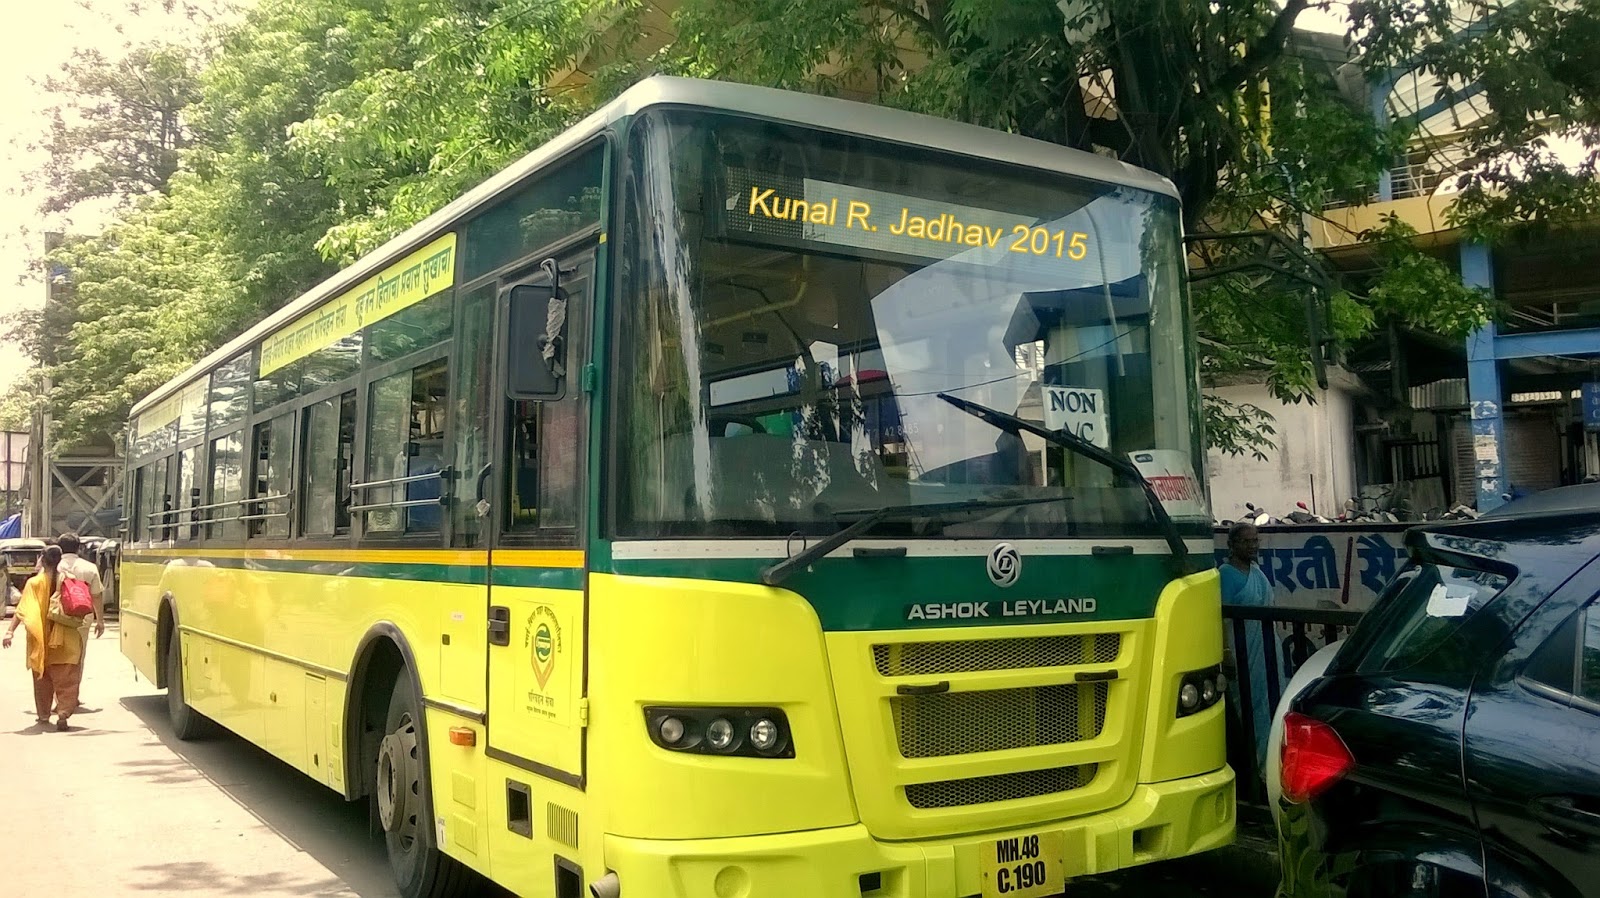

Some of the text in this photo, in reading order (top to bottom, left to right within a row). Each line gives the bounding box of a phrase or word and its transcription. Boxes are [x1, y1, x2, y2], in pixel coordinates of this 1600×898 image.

[376, 275, 400, 310] हिताचा
[401, 263, 421, 294] प्रवास
[423, 246, 452, 294] सुखाचा
[1048, 390, 1096, 414] NON
[908, 598, 1097, 620] ASHOK LEYLAND
[996, 834, 1039, 864] MH.48
[997, 860, 1046, 894] C.190
